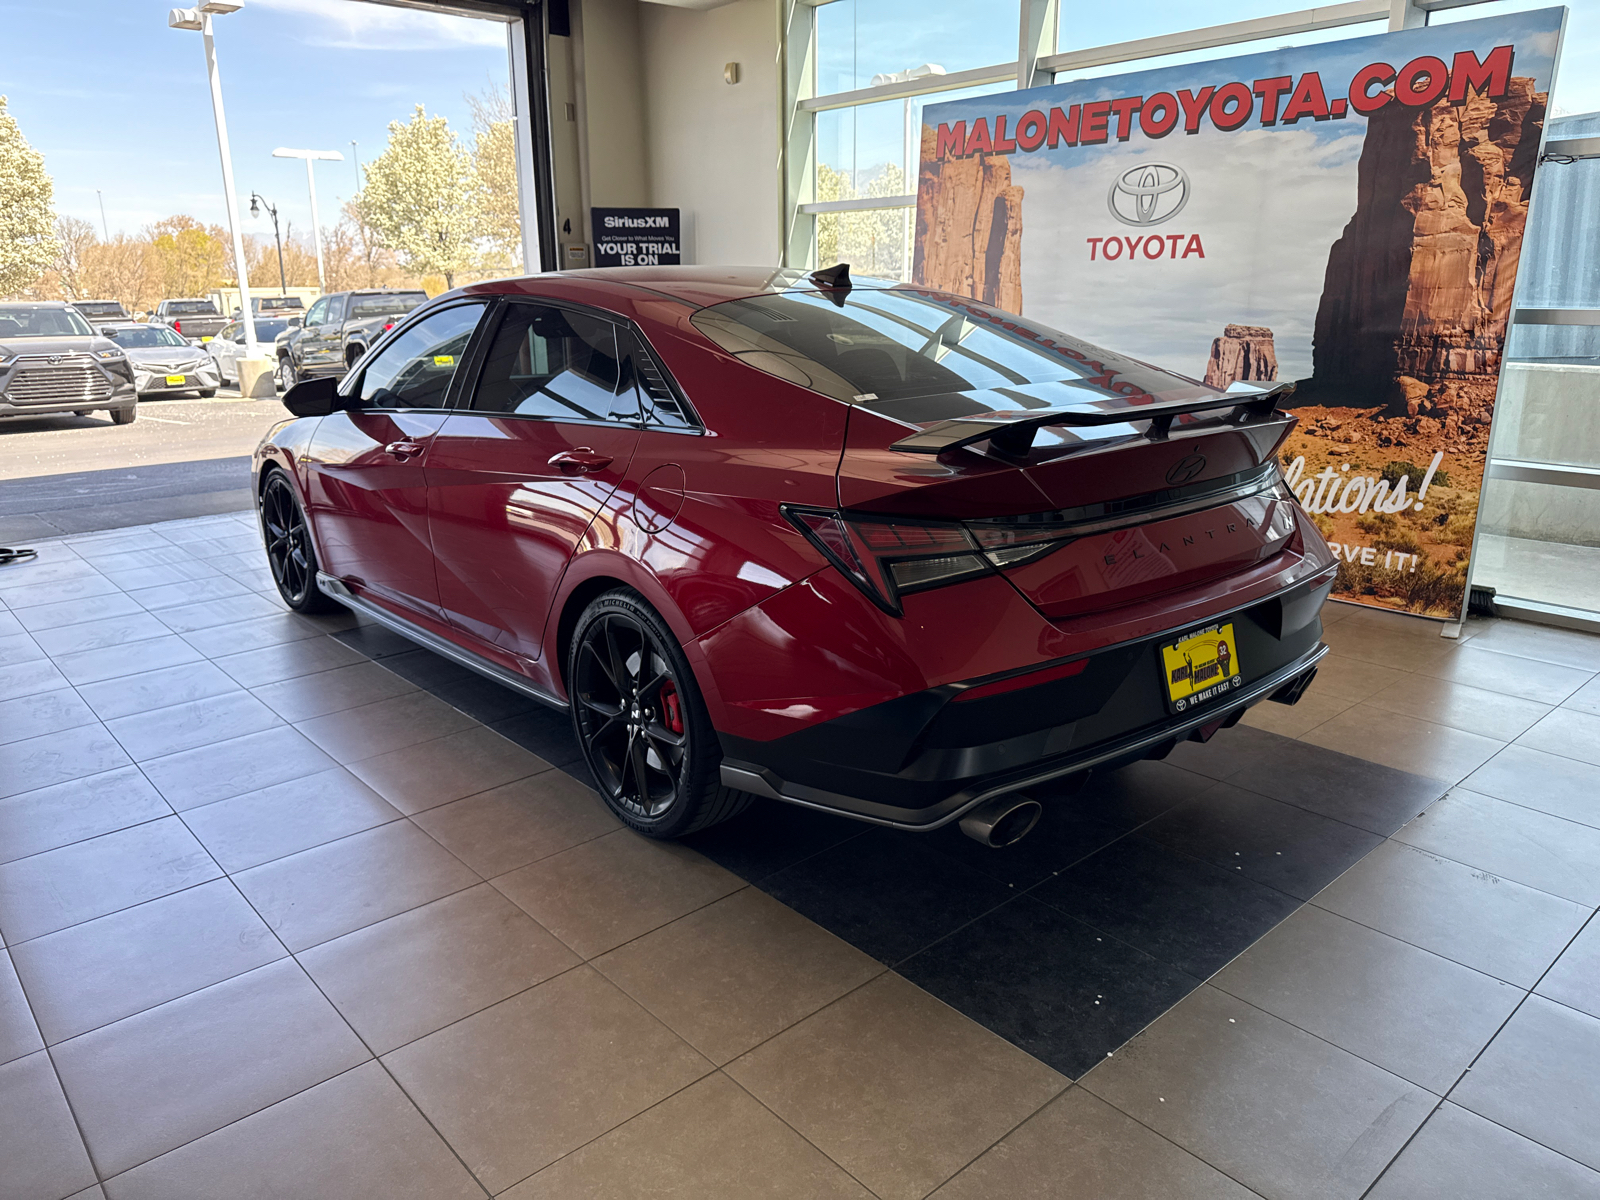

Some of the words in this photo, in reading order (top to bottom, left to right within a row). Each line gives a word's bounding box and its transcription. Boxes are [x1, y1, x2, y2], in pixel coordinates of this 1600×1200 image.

[936, 44, 1516, 162] MALONETOYOTA.COM
[564, 218, 571, 234] 4
[604, 216, 669, 228] SiriusXM
[597, 243, 637, 255] YOUR
[639, 243, 680, 254] TRIAL
[1086, 233, 1206, 262] TOYOTA
[620, 254, 635, 266] IS
[637, 254, 659, 265] ON
[1104, 517, 1255, 566] ELANTRA
[1283, 515, 1294, 530] N
[1384, 550, 1418, 573] IT!
[603, 599, 635, 612] MICHELIN
[1219, 645, 1227, 656] 32
[1171, 664, 1189, 685] KARL
[1194, 662, 1219, 685] MALONE
[1189, 696, 1198, 705] WE
[1198, 689, 1212, 701] MAKE
[1212, 686, 1218, 695] IT
[1217, 681, 1230, 693] EASY
[631, 709, 641, 719] N
